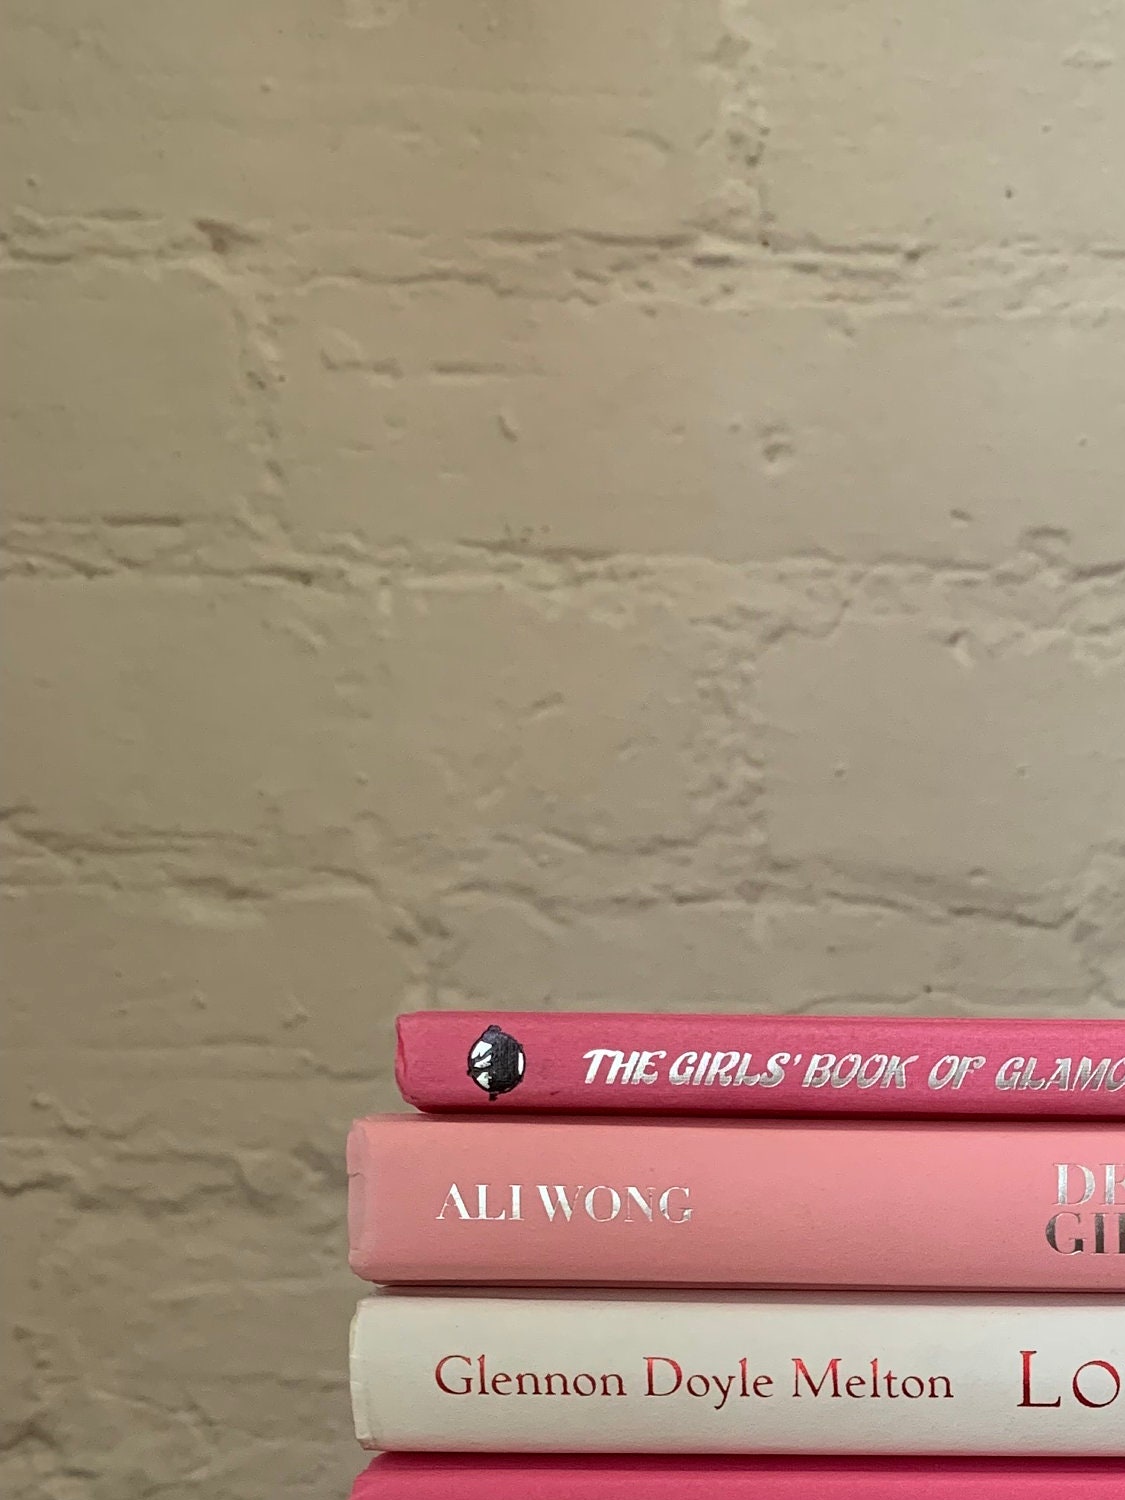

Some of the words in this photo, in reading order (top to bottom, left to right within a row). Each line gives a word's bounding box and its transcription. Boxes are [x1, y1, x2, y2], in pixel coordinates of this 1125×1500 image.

[582, 1048, 667, 1084] THE
[802, 1053, 920, 1089] BOOK
[927, 1055, 986, 1090] OF
[435, 1183, 524, 1220] ALI
[536, 1184, 693, 1224] WONG
[435, 1355, 627, 1397] Glennon
[643, 1357, 774, 1409] Doyle
[791, 1358, 954, 1398] Melton
